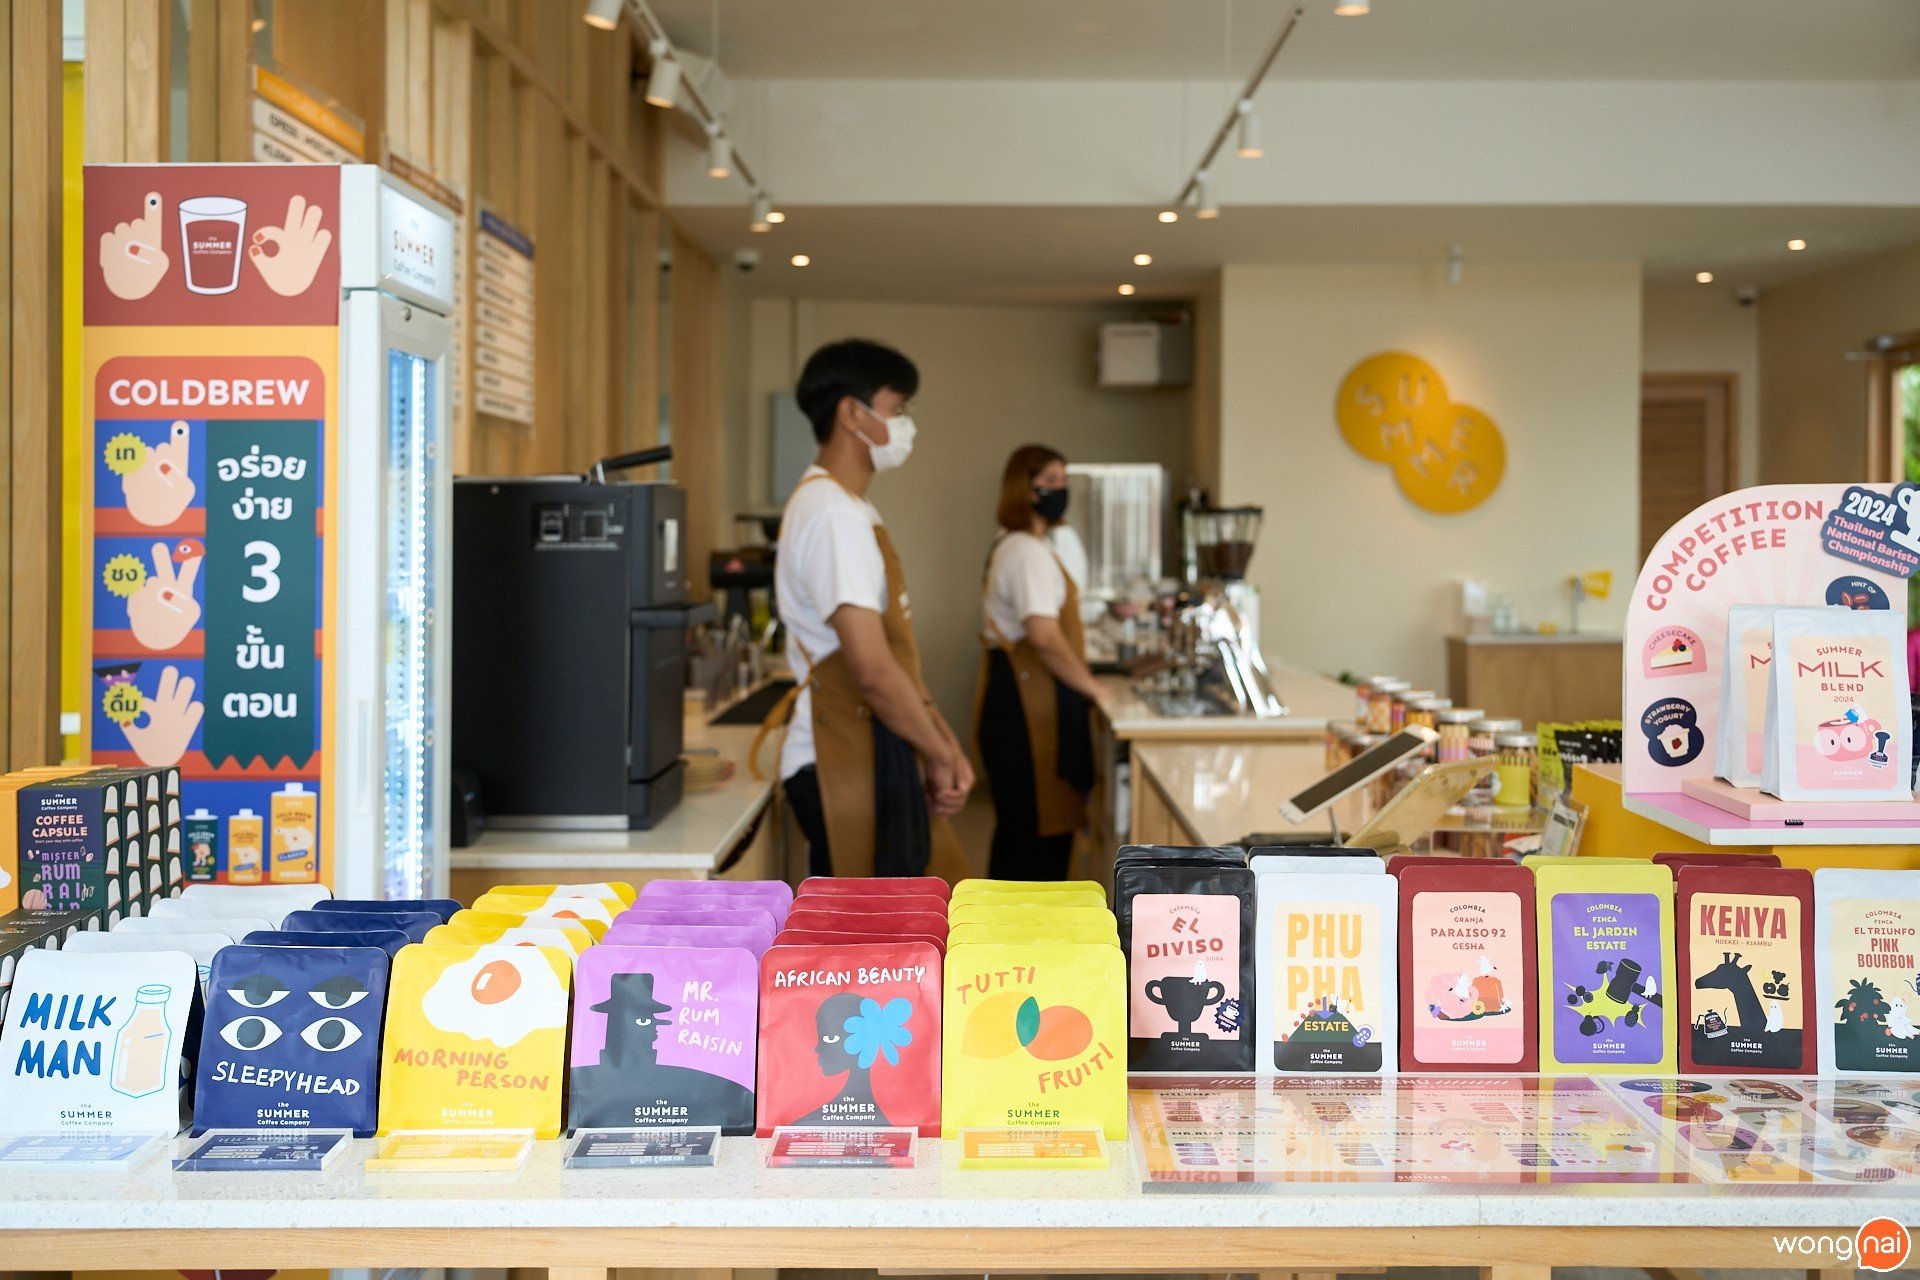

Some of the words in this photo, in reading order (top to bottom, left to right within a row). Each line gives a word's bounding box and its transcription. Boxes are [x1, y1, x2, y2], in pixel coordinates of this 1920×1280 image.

[108, 378, 310, 406] COLDBREW
[116, 447, 136, 460] เท
[216, 444, 307, 481] อร่อย
[232, 487, 293, 520] ง่าย
[1844, 492, 1898, 526] 2024
[1834, 516, 1885, 540] Thailand
[1646, 500, 1823, 611] COMPETITION
[1827, 526, 1876, 550] National
[1878, 543, 1918, 565] Barista
[1686, 528, 1786, 592] COFFEE
[1828, 540, 1910, 575] Championship
[112, 568, 137, 582] ชง
[242, 540, 282, 603] 3
[236, 624, 285, 669] ขั้น
[1649, 630, 1697, 651] CHEESECAKE
[1816, 646, 1863, 657] SUMMER
[1798, 660, 1885, 679] MILK
[1821, 682, 1864, 692] BLEND
[111, 688, 138, 712] ดื่ม
[222, 692, 297, 718] ตอน
[1645, 704, 1691, 725] STRAWBERRY
[1653, 712, 1684, 726] YOGURT
[36, 815, 83, 825] COFFEE
[32, 827, 88, 837] CAPSULE
[42, 852, 80, 861] MISTER
[41, 863, 80, 880] RUM
[42, 882, 80, 899] RAI
[1450, 904, 1486, 913] COLOMBIA
[1586, 904, 1623, 914] COLOMBIA
[1865, 910, 1902, 919] COLOMBIA
[1172, 916, 1200, 934] EL
[1700, 904, 1787, 939] KENYA
[1868, 927, 1915, 936] TRIUNFO
[1287, 913, 1362, 959] PHU
[1574, 927, 1589, 936] EL
[1593, 927, 1638, 938] JARDIN
[1147, 937, 1224, 958] DIVISO
[1586, 941, 1626, 950] ESTATE
[1871, 938, 1899, 952] PINK
[1858, 954, 1915, 969] BOURBON
[775, 969, 850, 988] AFRICAN
[857, 965, 926, 985] BEAUTY
[956, 966, 1035, 1004] TUTTI
[682, 981, 720, 1003] MR.
[1287, 965, 1364, 1011] PHA
[20, 992, 117, 1031] MILK
[678, 1007, 720, 1026] RUM
[1304, 1021, 1349, 1032] ESTATE
[677, 1028, 743, 1056] RAISIN
[15, 1039, 101, 1079] MAN
[394, 1048, 508, 1070] MORNING
[1038, 1042, 1113, 1094] FRUITI
[212, 1060, 360, 1096] SLEEPYHEAD
[456, 1070, 549, 1091] PERSON
[60, 1111, 113, 1119] SUMMER
[257, 1109, 310, 1118] SUMMER
[441, 1108, 494, 1118] SUMMER
[634, 1107, 688, 1116] SUMMER
[822, 1103, 875, 1113] SUMMER
[1007, 1110, 1060, 1118] SUMMER
